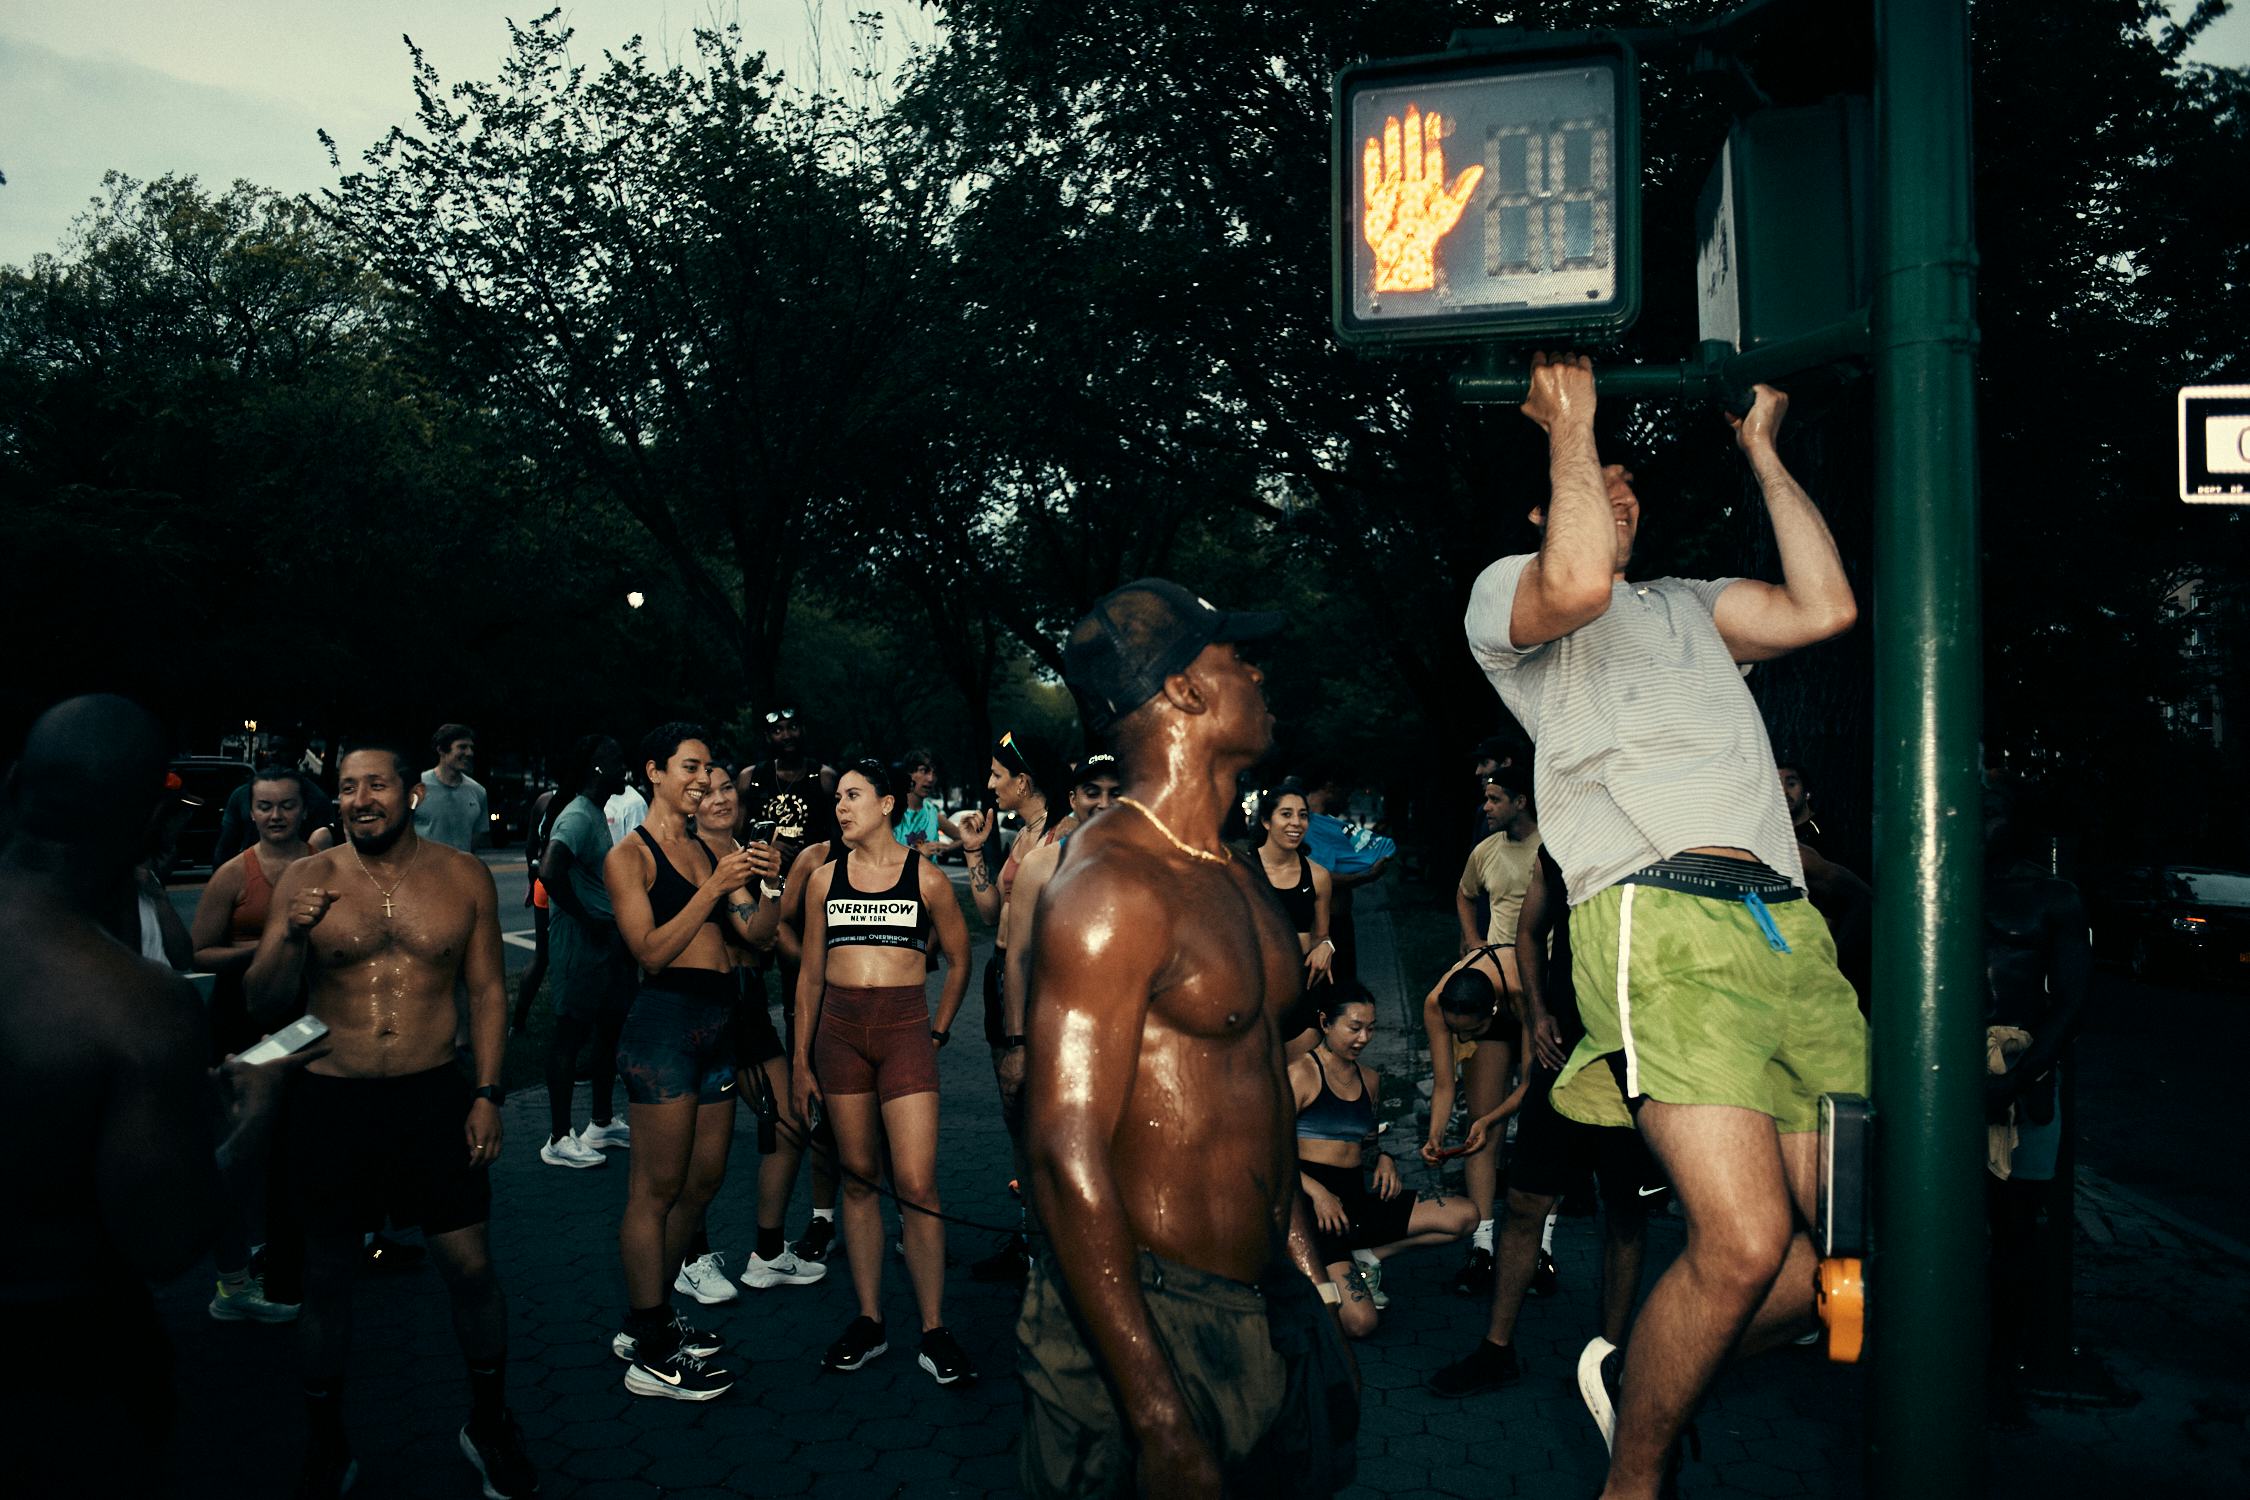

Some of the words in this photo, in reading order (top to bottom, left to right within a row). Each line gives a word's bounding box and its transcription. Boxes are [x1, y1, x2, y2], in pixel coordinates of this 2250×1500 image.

[1669, 872, 1716, 888] DIVISION
[828, 903, 915, 915] OVERTHROW
[868, 933, 910, 943] OVERTHROW
